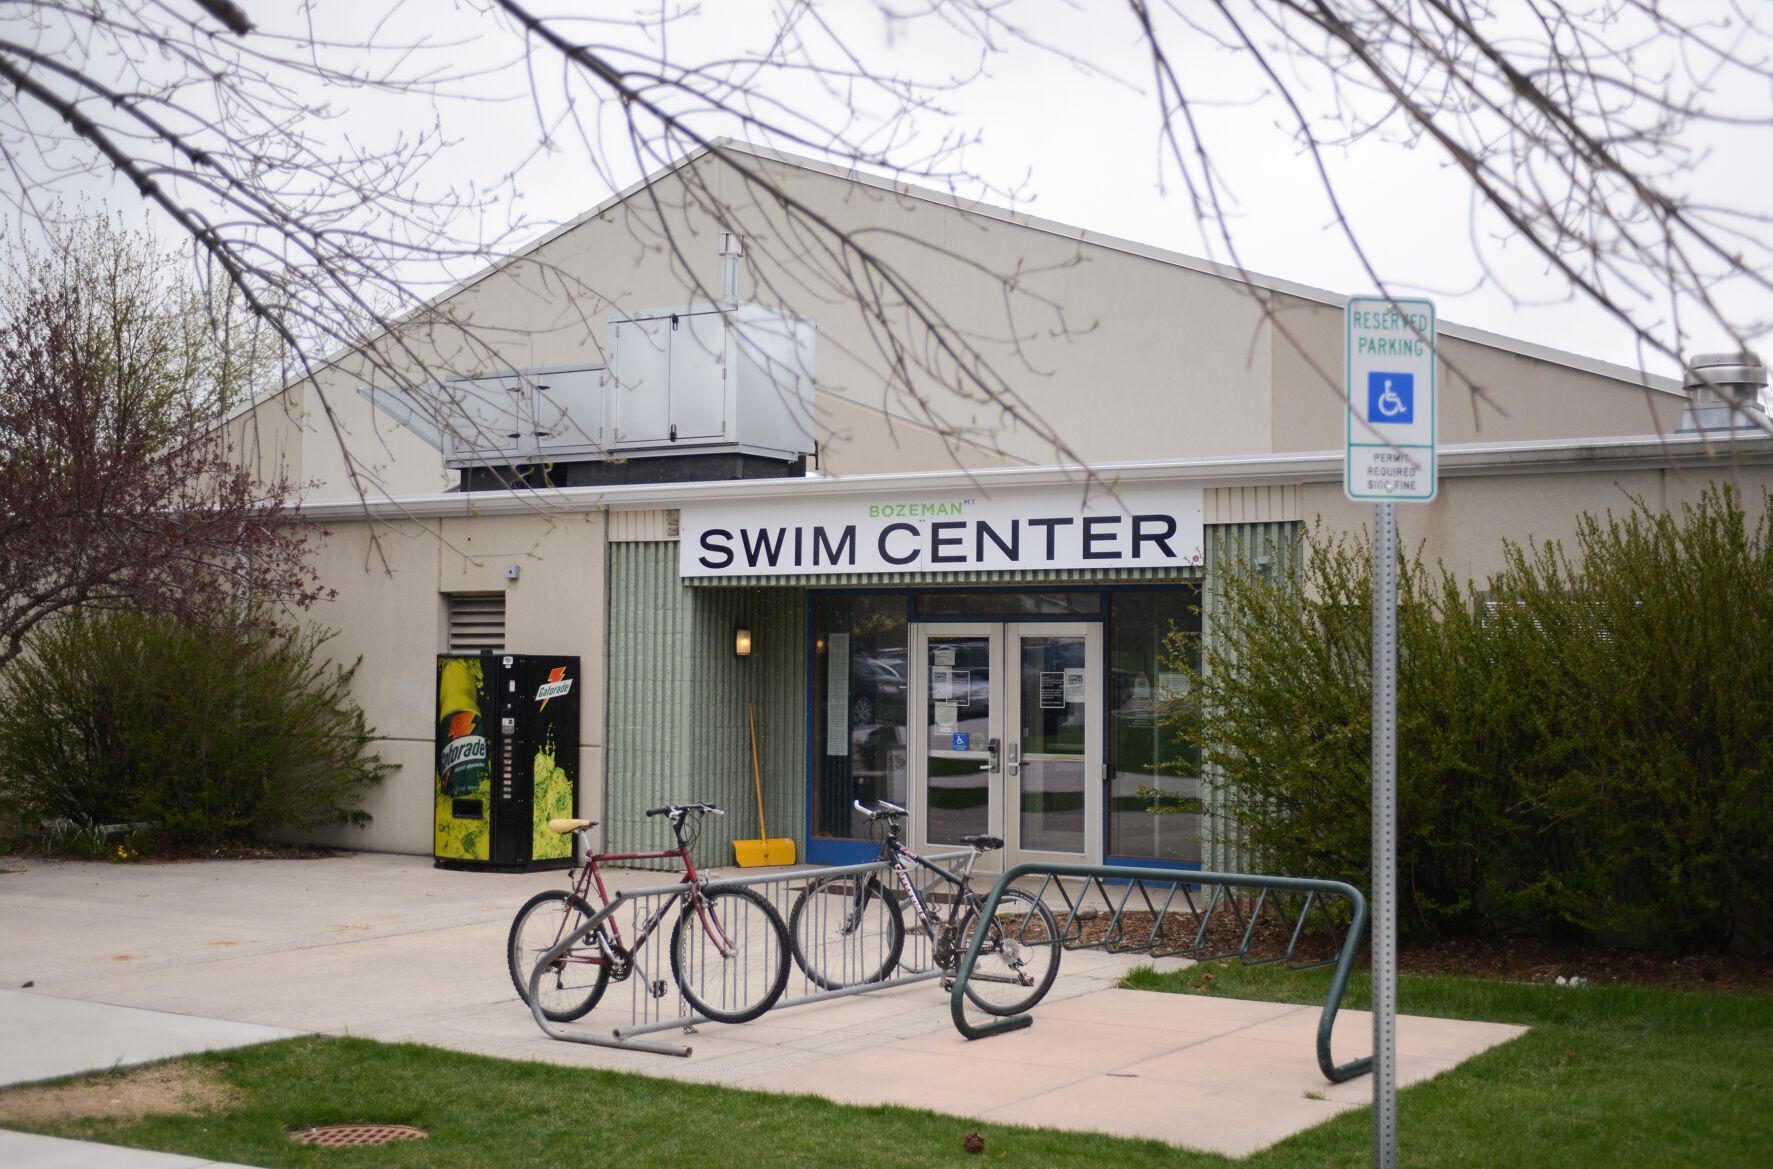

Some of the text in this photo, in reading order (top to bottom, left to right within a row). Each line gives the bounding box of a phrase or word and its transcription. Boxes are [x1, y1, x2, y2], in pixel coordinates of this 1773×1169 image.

[1353, 311, 1428, 332] RESERVED
[1358, 336, 1424, 357] PARKING
[1373, 452, 1409, 463] PERMIT
[1367, 466, 1416, 477] REQUIRED
[1394, 480, 1416, 490] FINE
[869, 502, 963, 518] BOZEMAN
[699, 514, 1178, 568] SWIM CENTER
[538, 683, 570, 698] Gatorade
[441, 739, 485, 767] atorade
